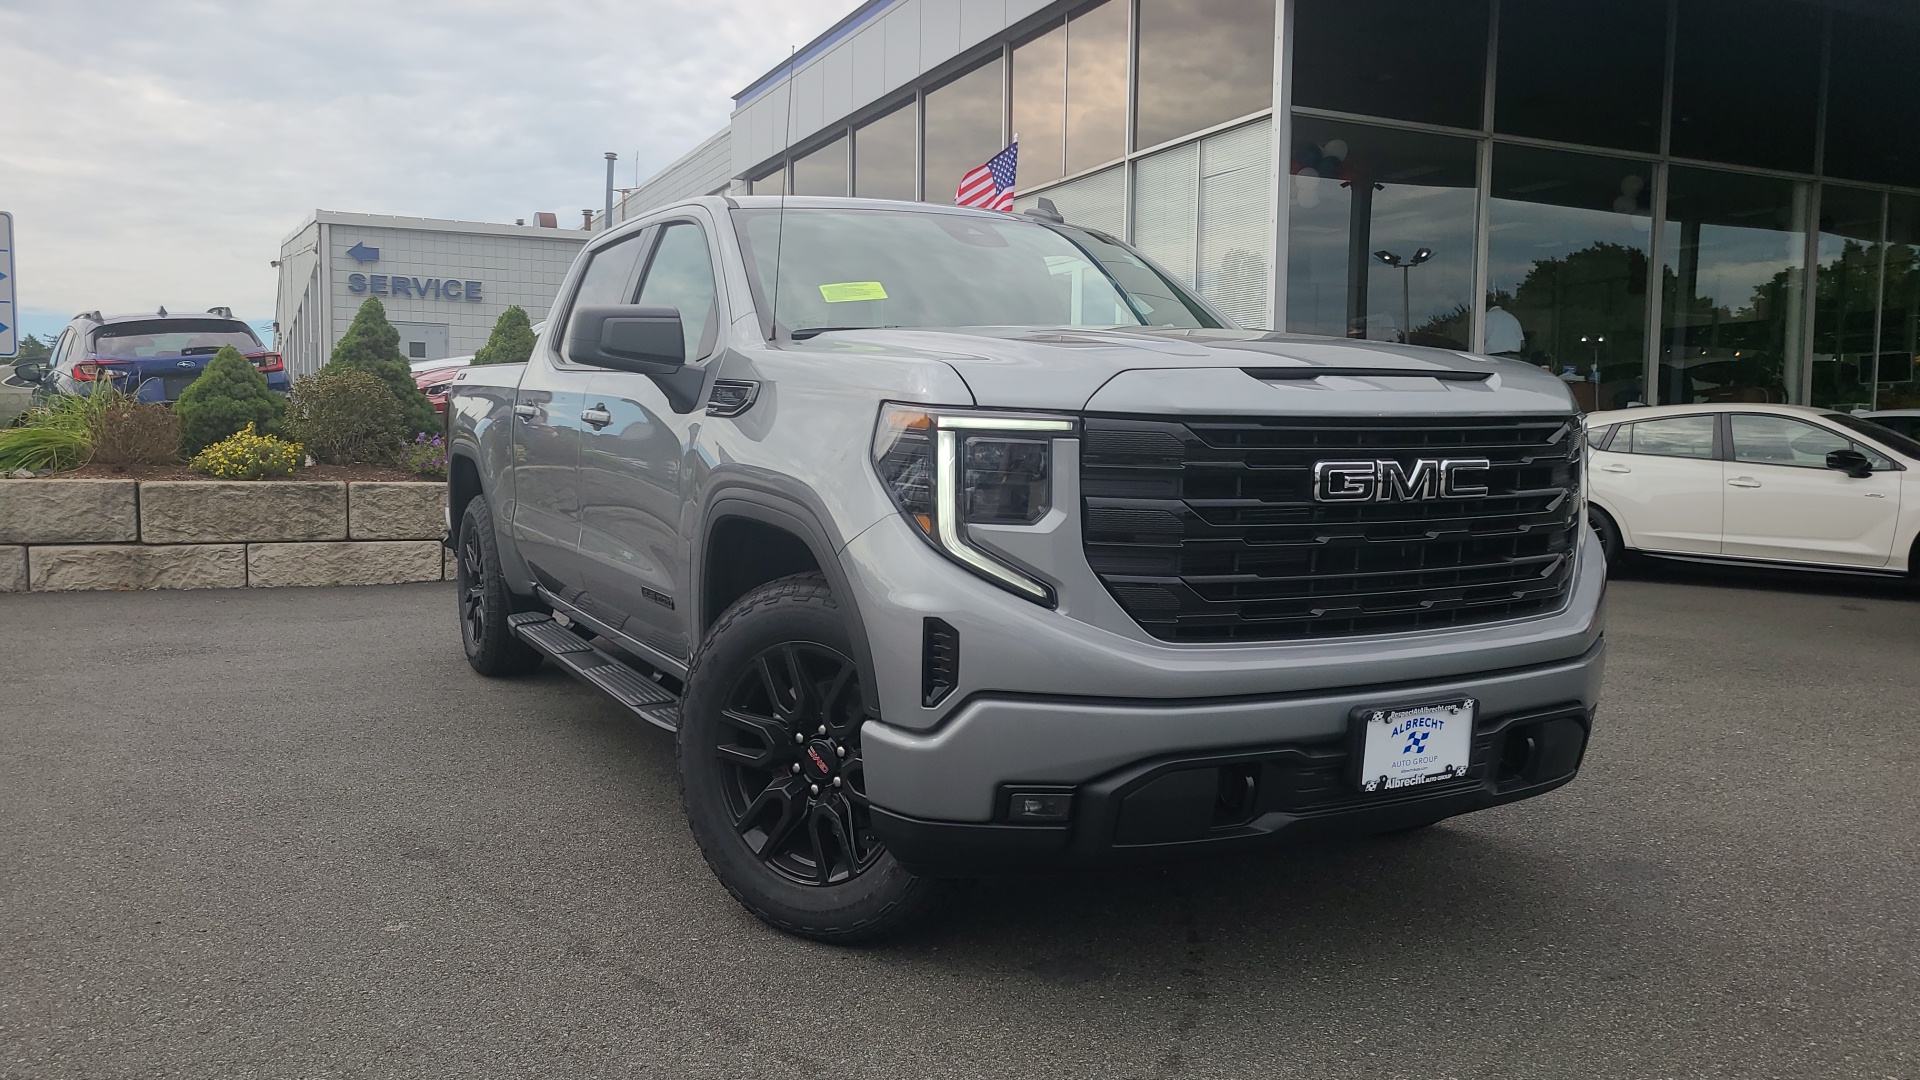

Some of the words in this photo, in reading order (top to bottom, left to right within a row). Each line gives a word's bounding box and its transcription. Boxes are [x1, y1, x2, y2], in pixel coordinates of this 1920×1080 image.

[348, 273, 483, 302] SERVICE
[1314, 459, 1490, 502] GMC
[1391, 717, 1444, 738] ALBRECHT
[1391, 759, 1411, 769] AUTO
[1412, 755, 1438, 765] GROUP
[1384, 773, 1426, 790] Albrecht
